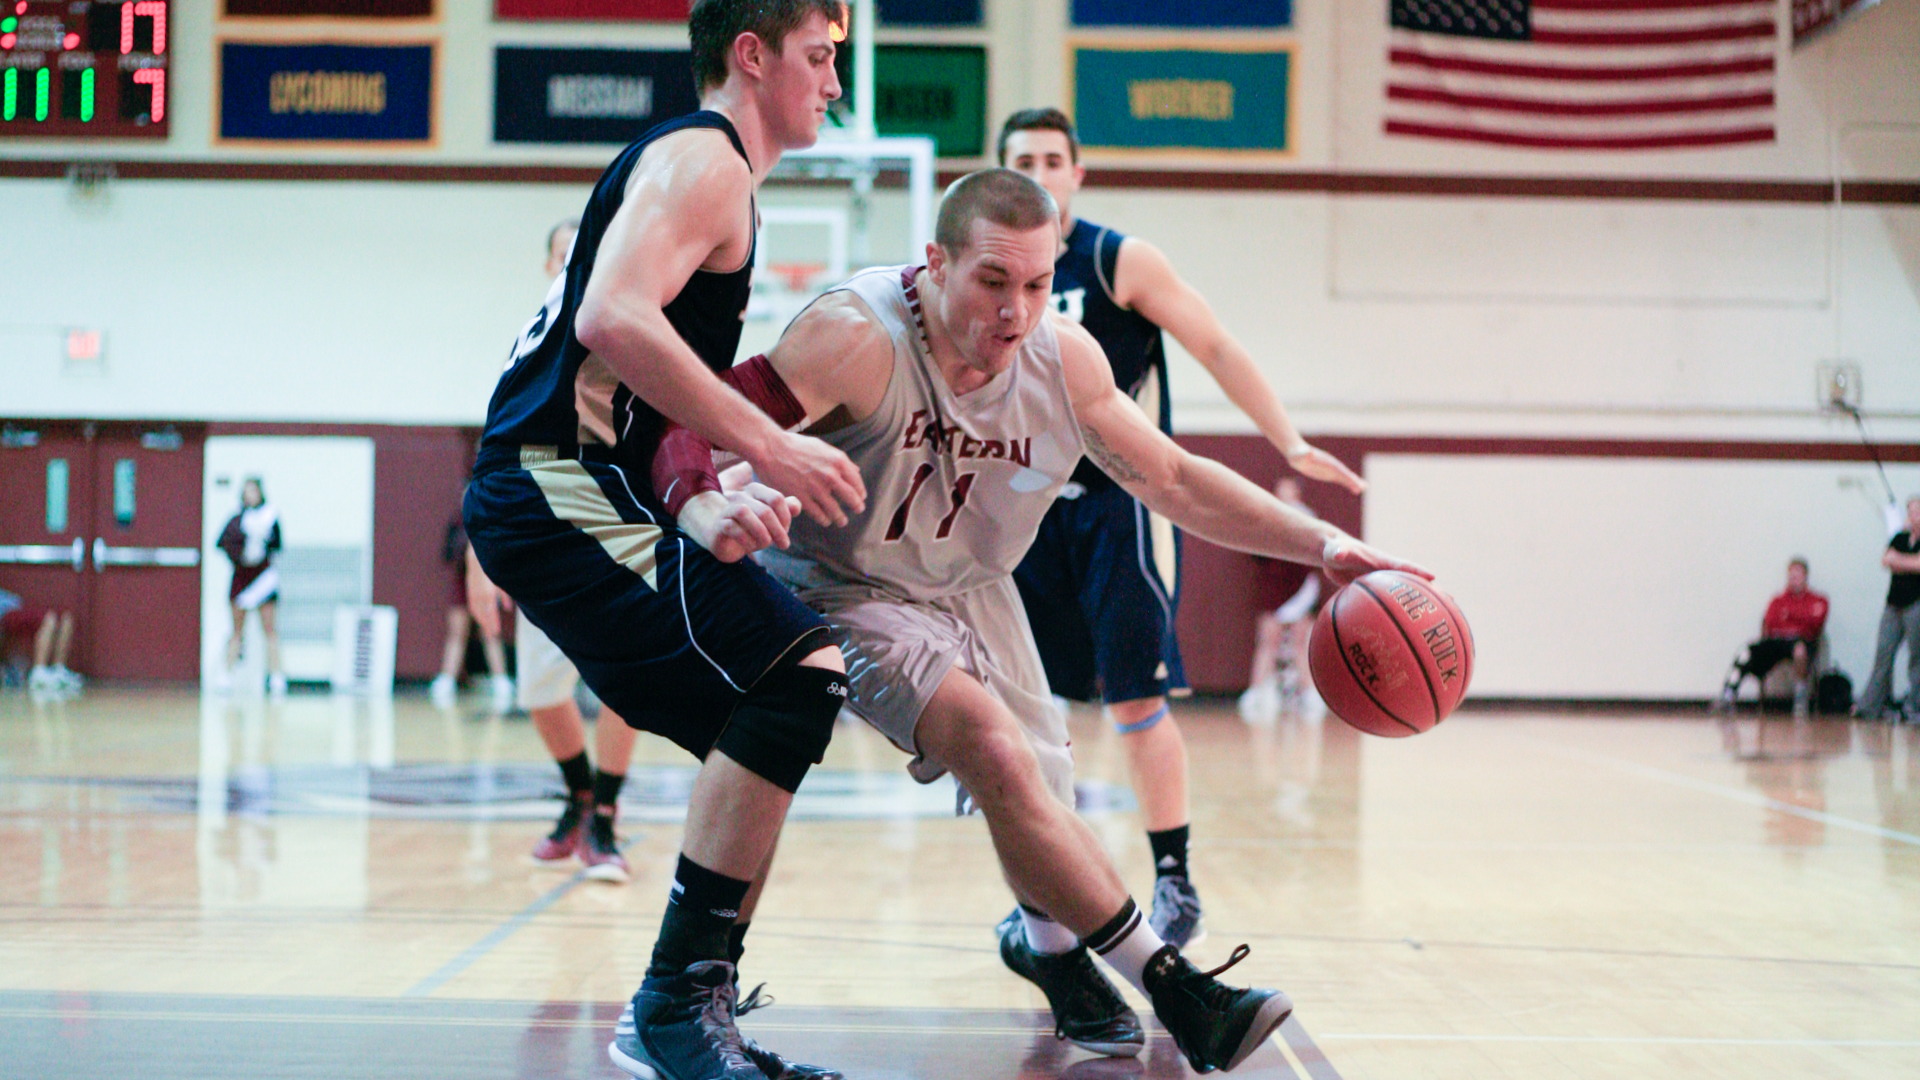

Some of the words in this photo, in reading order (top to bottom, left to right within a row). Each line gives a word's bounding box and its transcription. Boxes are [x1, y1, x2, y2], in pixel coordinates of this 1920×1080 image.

[120, 1, 166, 55] 17
[133, 68, 165, 123] 7
[269, 71, 386, 114] LYCOMING
[901, 408, 1032, 469] EATERN
[882, 462, 979, 543] 11
[1388, 580, 1437, 622] THE
[1422, 619, 1459, 687] ROCK
[1348, 642, 1380, 686] ROCK
